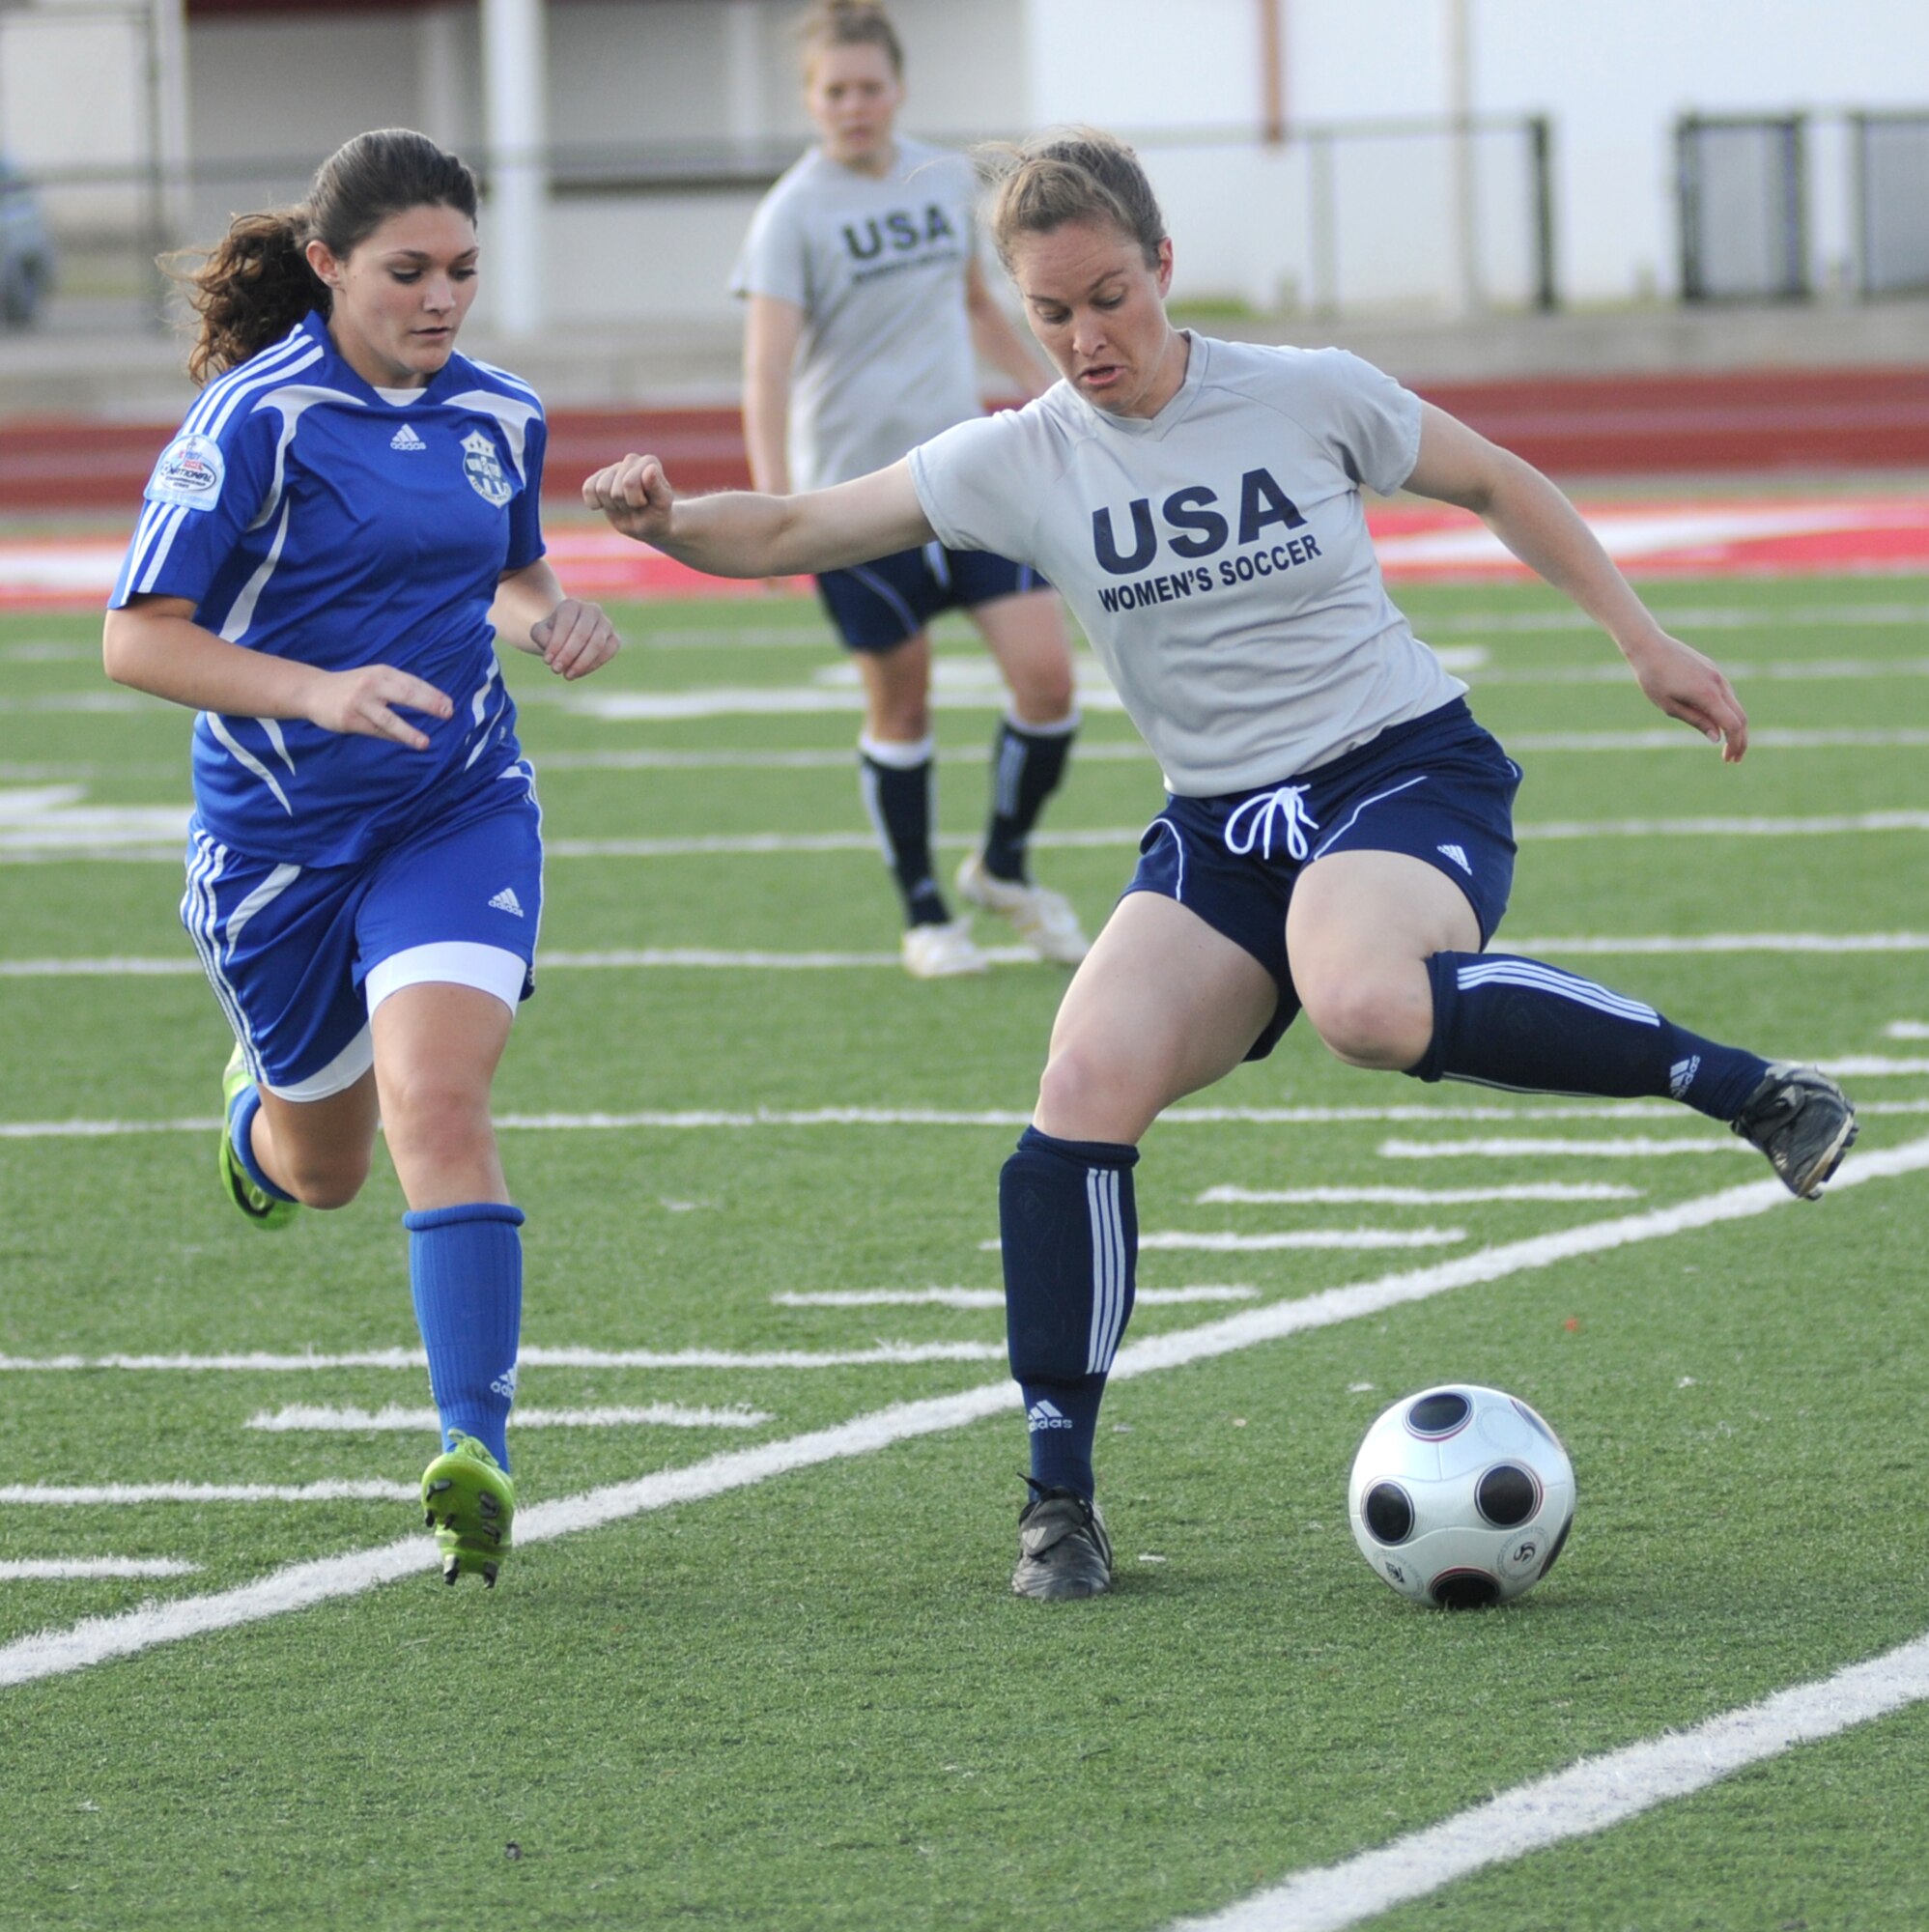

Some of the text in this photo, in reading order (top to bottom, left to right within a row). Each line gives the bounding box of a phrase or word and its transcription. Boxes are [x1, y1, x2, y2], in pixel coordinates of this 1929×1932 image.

[841, 203, 956, 261] USA
[389, 440, 427, 451] adidas
[1092, 468, 1309, 575] USA
[1097, 534, 1322, 613] WOMEN'S SOCCER
